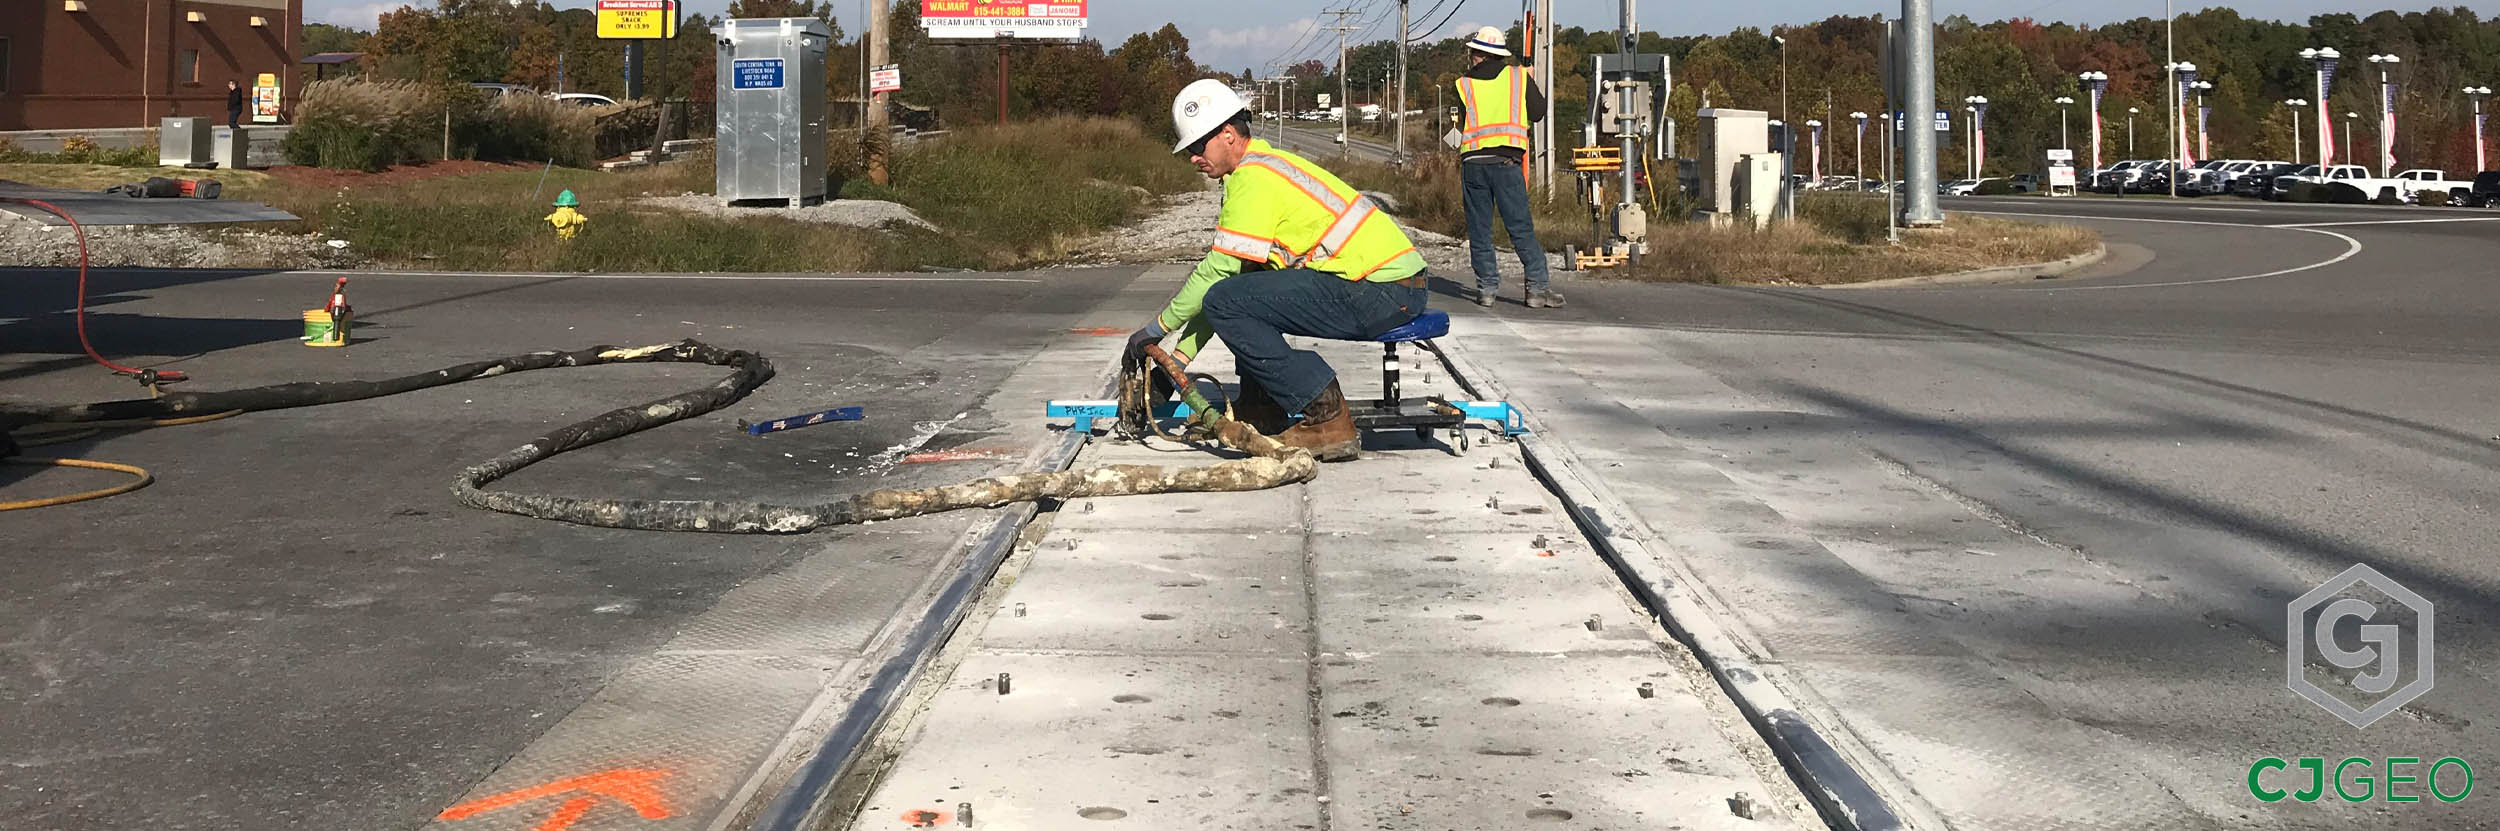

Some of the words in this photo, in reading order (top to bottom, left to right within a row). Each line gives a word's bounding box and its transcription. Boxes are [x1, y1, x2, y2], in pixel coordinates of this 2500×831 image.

[929, 2, 969, 11] WALMART
[1049, 7, 1079, 15] JANOME
[926, 18, 961, 26] SCREAM
[963, 18, 987, 26] UNTIL
[989, 18, 1013, 26] YOUR
[1014, 18, 1054, 26] HUSBAND
[1056, 18, 1083, 26] STOPS
[1064, 405, 1085, 416] PHR
